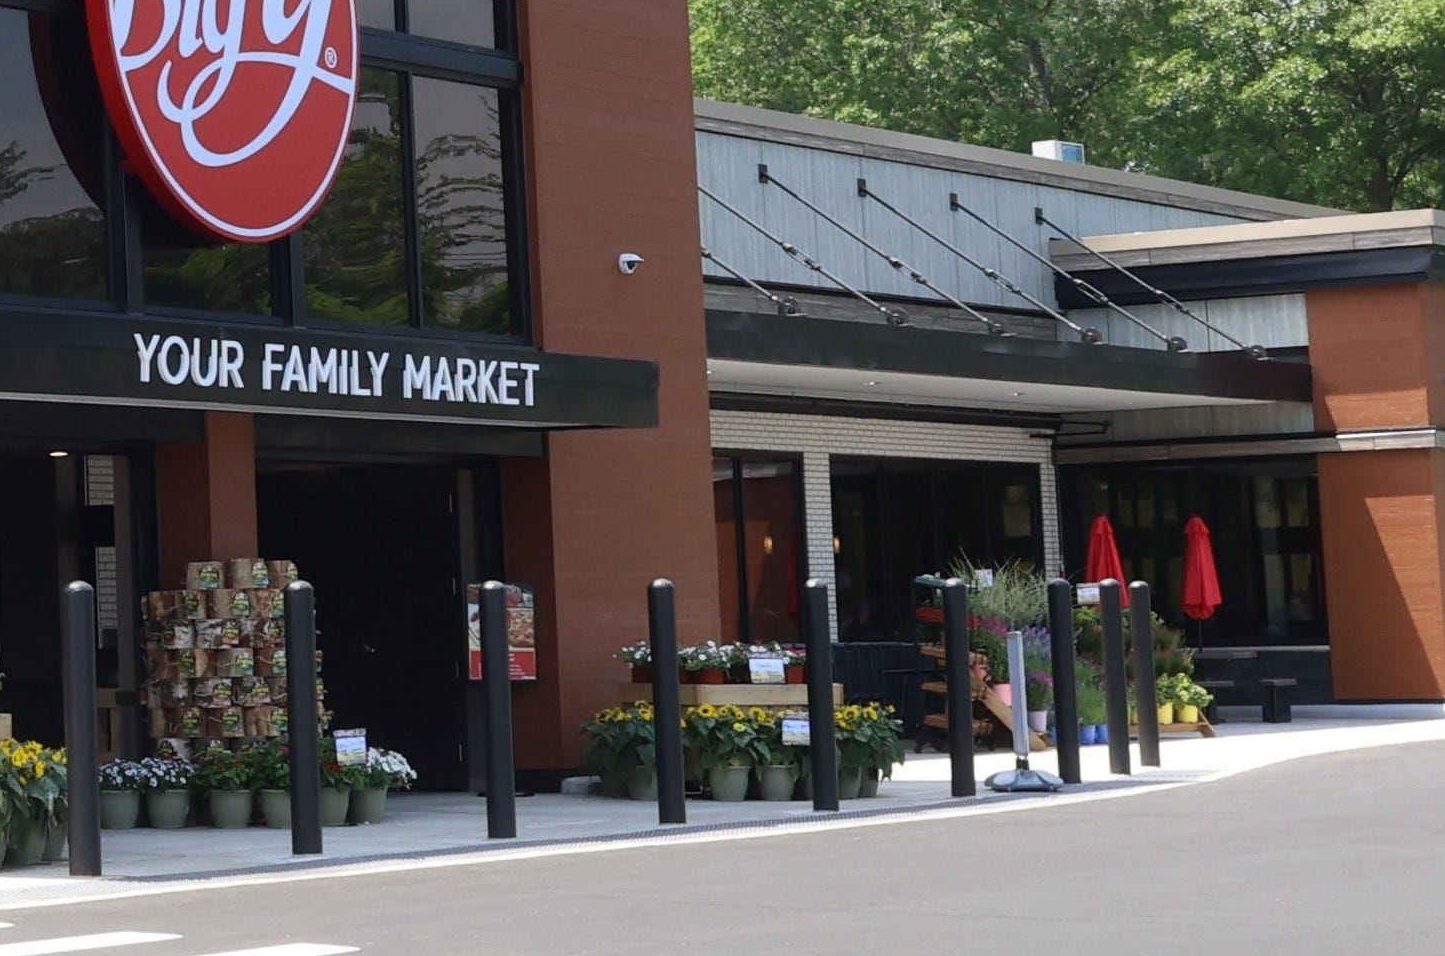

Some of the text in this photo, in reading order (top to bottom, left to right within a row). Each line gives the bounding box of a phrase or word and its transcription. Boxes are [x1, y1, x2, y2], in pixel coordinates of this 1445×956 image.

[133, 333, 540, 407] YOUR FAMILY MARKET
